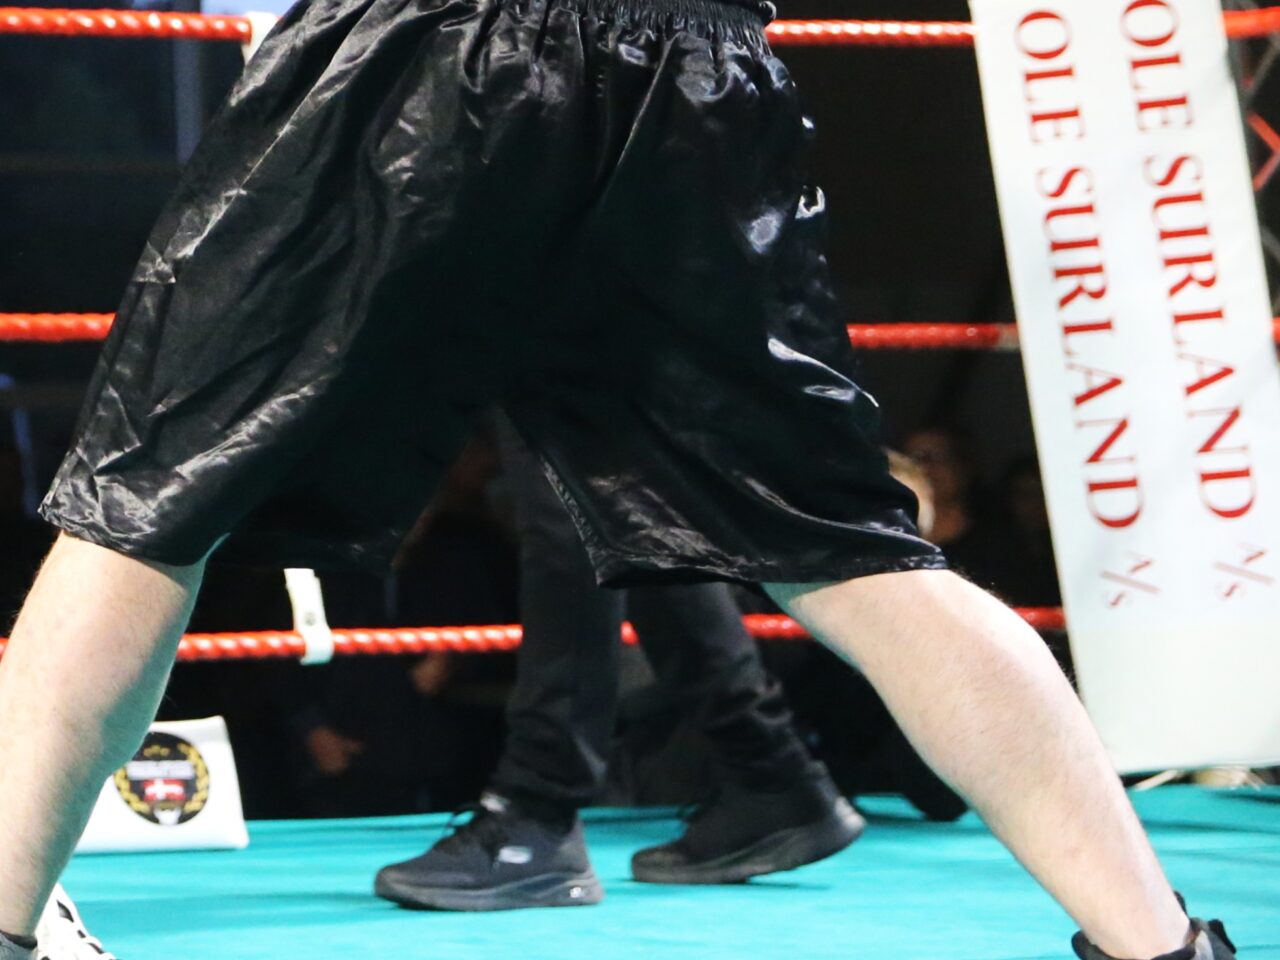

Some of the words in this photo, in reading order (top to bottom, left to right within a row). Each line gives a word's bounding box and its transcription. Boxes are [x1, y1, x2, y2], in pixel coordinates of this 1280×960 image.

[1014, 9, 1087, 144] OLE
[1035, 166, 1145, 531] SURLAND
[1142, 153, 1258, 520] SURLAND
